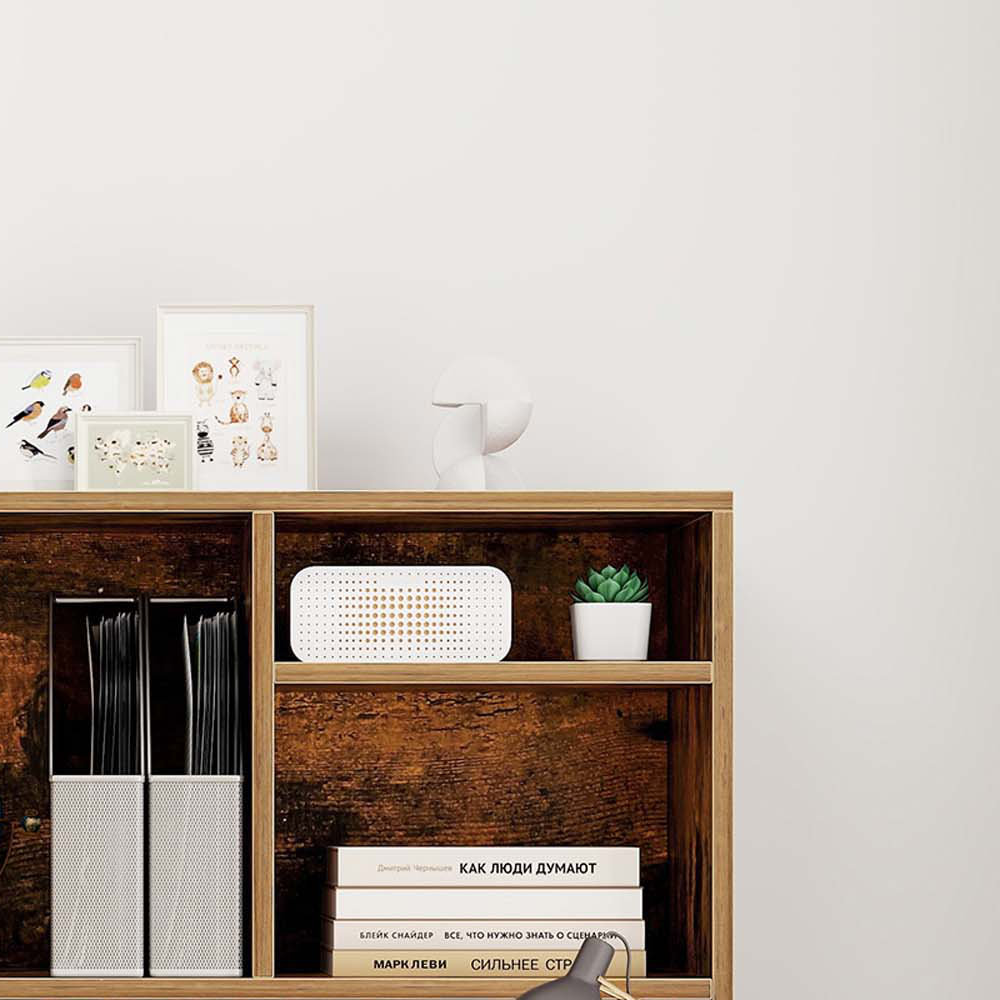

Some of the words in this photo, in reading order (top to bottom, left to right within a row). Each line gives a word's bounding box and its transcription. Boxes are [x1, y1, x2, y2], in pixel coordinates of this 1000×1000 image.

[459, 862, 486, 874] КАК
[490, 862, 532, 874] ЛЮДИ
[535, 862, 597, 876] ДУМАЮТ
[359, 930, 389, 940] БЛЕЙК
[391, 930, 434, 940] СНАЙДЕР
[444, 931, 463, 941] ВСЕ,
[466, 931, 485, 939] ЧТО
[487, 931, 523, 939] НУЖНО
[526, 931, 554, 939] ЗНАТЬ
[557, 931, 564, 939] О
[373, 959, 409, 970] МАРК
[410, 959, 447, 970] ЛЕВИ
[471, 958, 539, 971] СИЛЬНЕЕ
[545, 958, 572, 971] СТР
